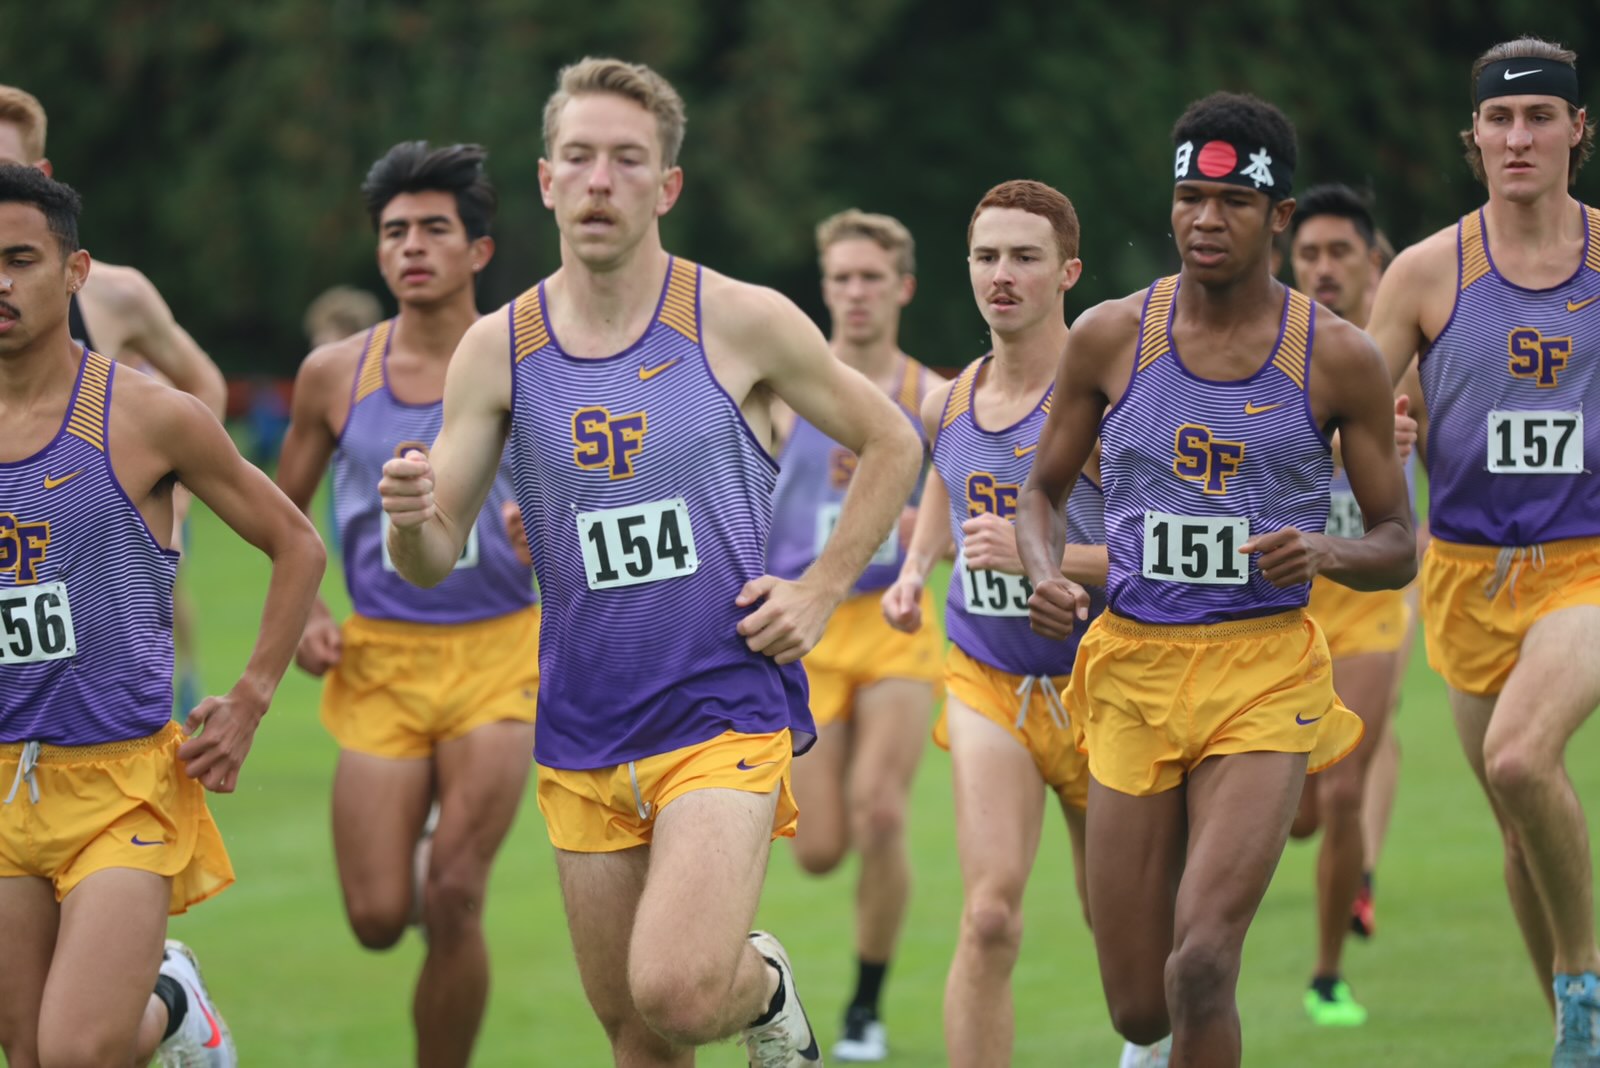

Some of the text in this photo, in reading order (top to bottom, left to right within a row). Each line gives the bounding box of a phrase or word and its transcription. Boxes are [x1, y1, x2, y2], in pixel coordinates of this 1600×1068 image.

[1508, 327, 1572, 389] SF
[571, 405, 647, 481] SF
[1173, 423, 1246, 495] SF
[1496, 419, 1576, 467] 157
[588, 509, 689, 578] 154
[1152, 521, 1239, 578] 151
[0, 593, 66, 658] 56
